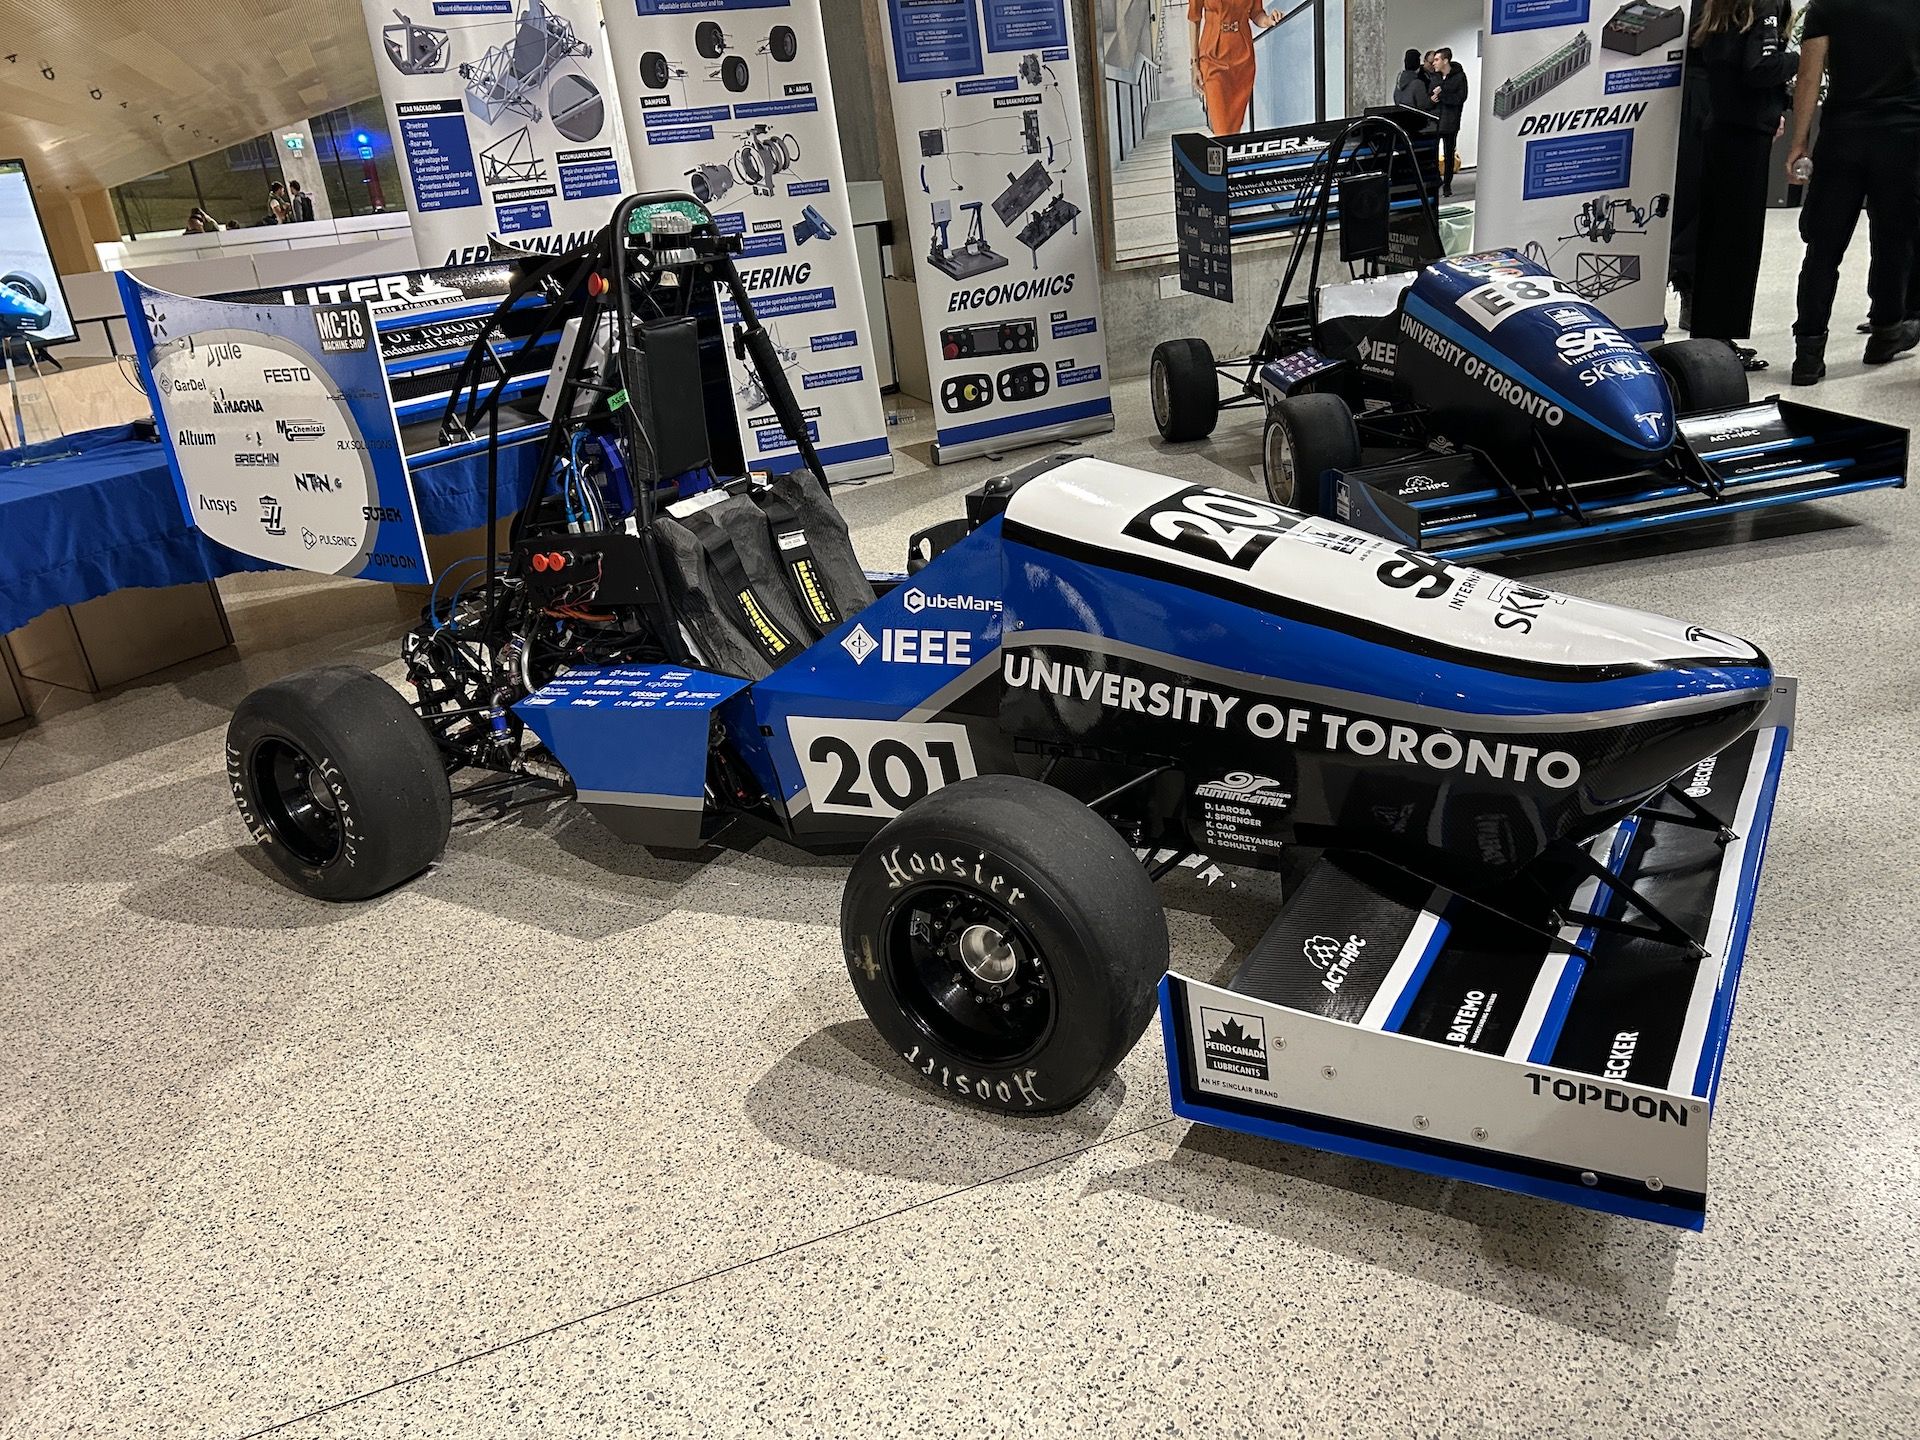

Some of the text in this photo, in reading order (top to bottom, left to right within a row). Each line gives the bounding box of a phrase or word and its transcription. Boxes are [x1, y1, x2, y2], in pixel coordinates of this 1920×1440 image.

[414, 104, 442, 112] PACKAGING
[644, 97, 668, 107] DAMPERS
[1517, 101, 1649, 137] DRIVETRAIN
[948, 273, 1076, 313] ERGONOMICS
[315, 309, 364, 340] MC-78
[322, 339, 366, 350] MACHINE SHOP
[1555, 327, 1634, 357] SAE
[1370, 340, 1398, 365] IEE
[1572, 346, 1642, 365] INTERNATIONAL
[263, 367, 311, 384] FESTO
[1400, 313, 1564, 427] UNIVERSITY OF TORONTO
[174, 378, 207, 392] GarDel
[223, 399, 264, 414] MAGNA
[179, 429, 216, 446] Altium
[293, 425, 326, 433] Chemicals
[234, 453, 280, 463] BRECHIN
[200, 494, 237, 516] Ansys
[319, 534, 358, 548] PULSENICS
[365, 552, 417, 569] TOPDON
[1376, 549, 1456, 599] SA
[903, 587, 1002, 614] CubeMars
[881, 628, 972, 666] IEEE
[1003, 653, 1581, 790] UNIVERSITY OF TORONTO
[809, 734, 962, 812] 201
[1204, 802, 1252, 817] D. LAROSA
[1204, 812, 1262, 828] J. SPRENGER
[1206, 820, 1237, 832] K. CAO
[1206, 829, 1217, 837] O.
[1207, 838, 1258, 853] R. SCHULTZ
[880, 845, 1026, 906] Hoosier
[1446, 990, 1485, 1043] BATEMO
[1205, 1040, 1266, 1060] PETRO-CANADA
[1603, 1031, 1640, 1079] ECKER
[904, 1046, 1046, 1107] Hoosier
[1213, 1060, 1261, 1078] LUBRICANTS
[1201, 1077, 1279, 1099] AN HF SINCLAIR BRAND
[1524, 1073, 1688, 1127] TOPDON
